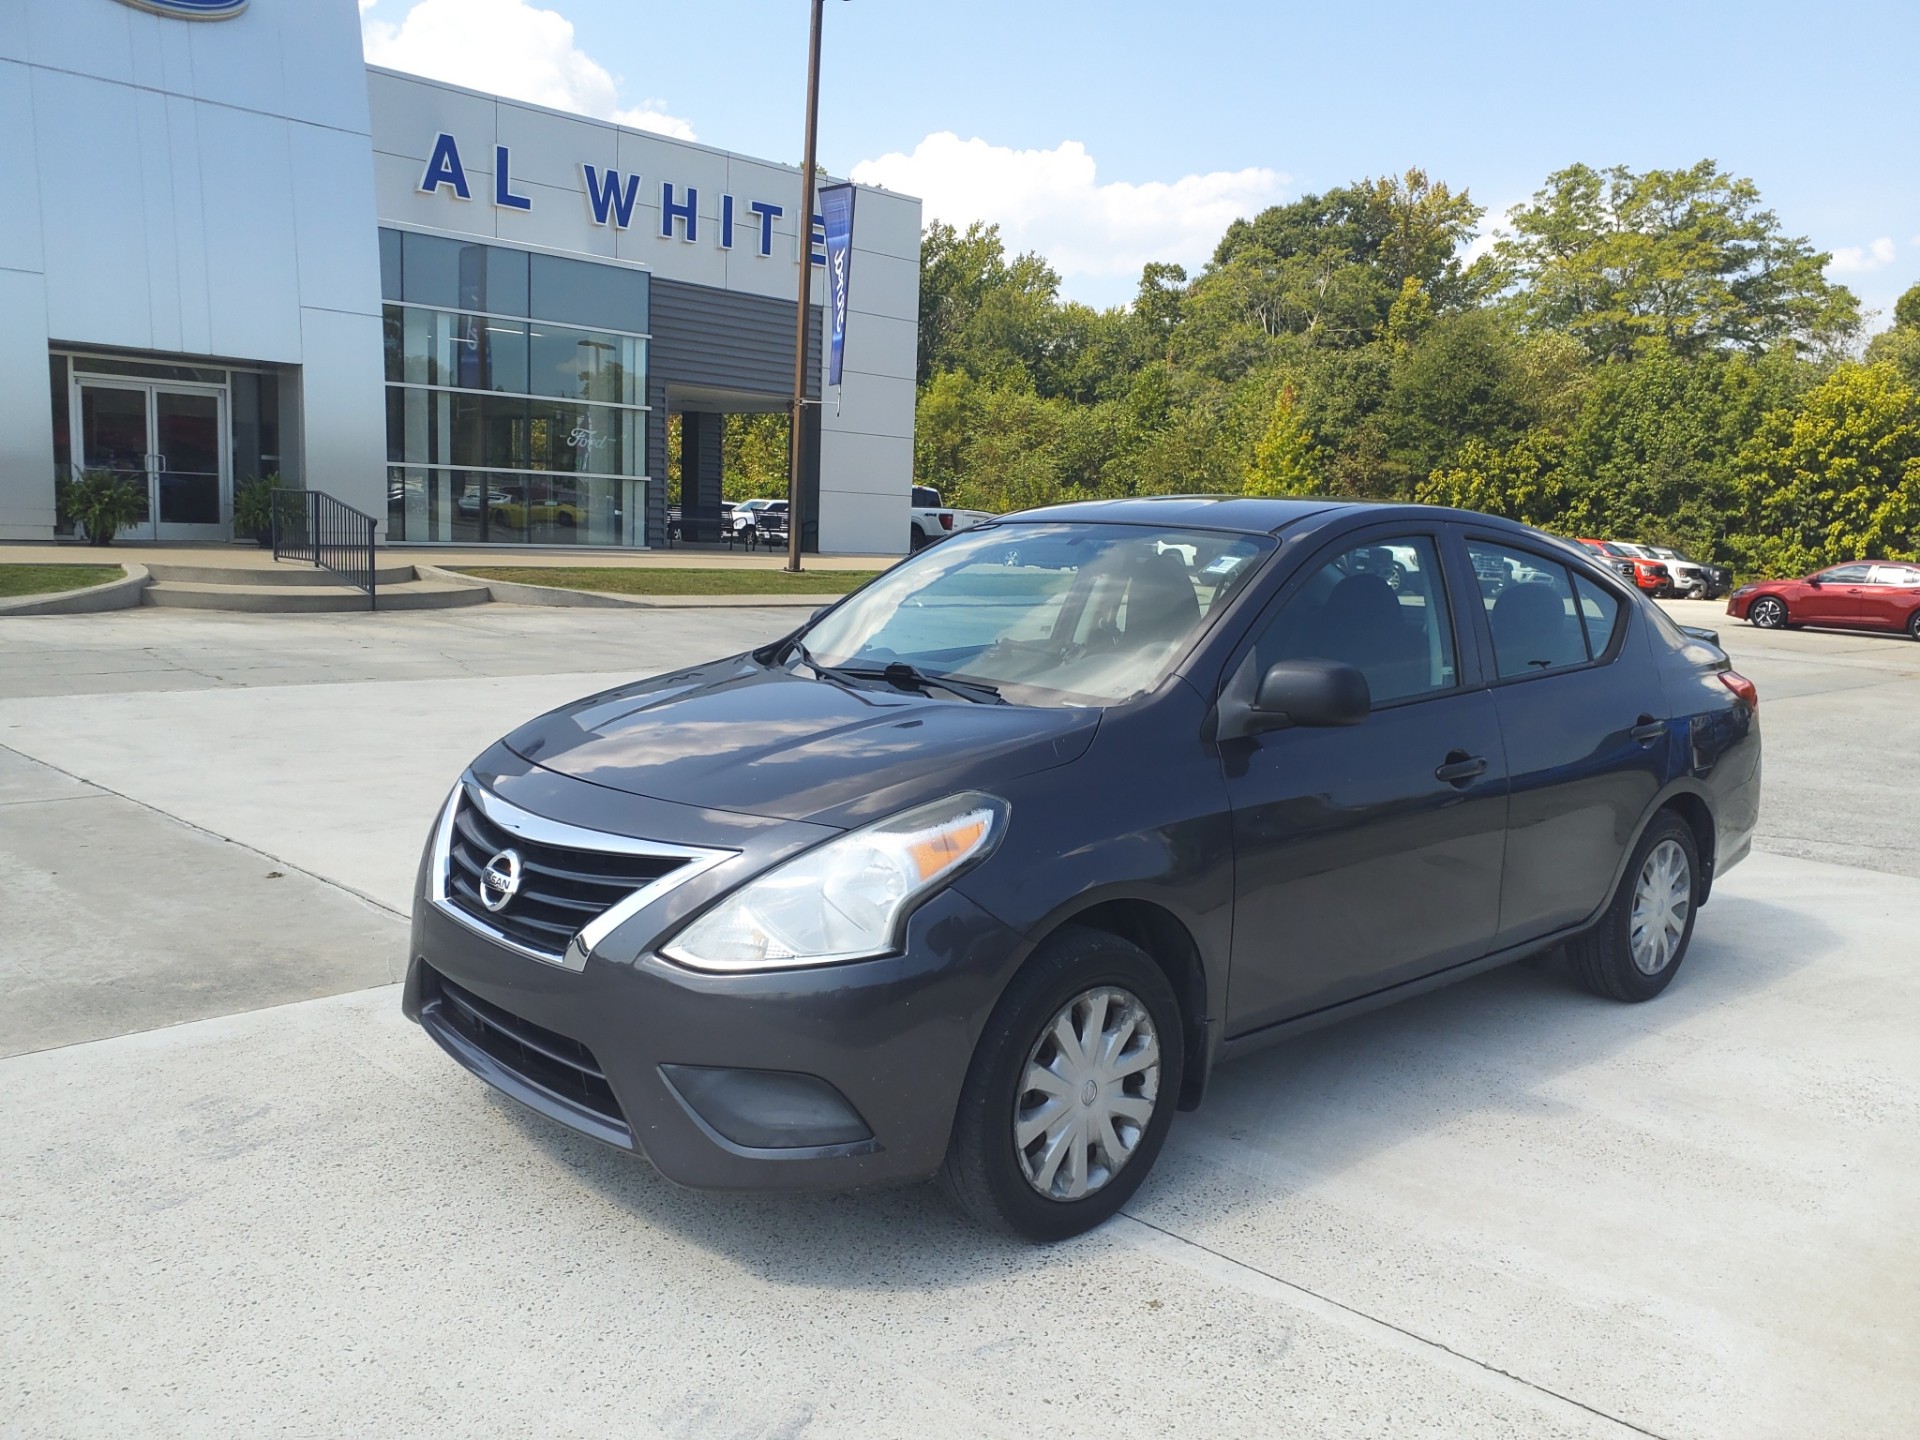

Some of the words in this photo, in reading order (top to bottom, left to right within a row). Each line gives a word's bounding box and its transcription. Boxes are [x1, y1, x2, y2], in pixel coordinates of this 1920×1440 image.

[418, 132, 532, 211] AL
[583, 163, 827, 266] WHITE
[567, 427, 608, 449] Ford
[483, 869, 511, 890] SAN
